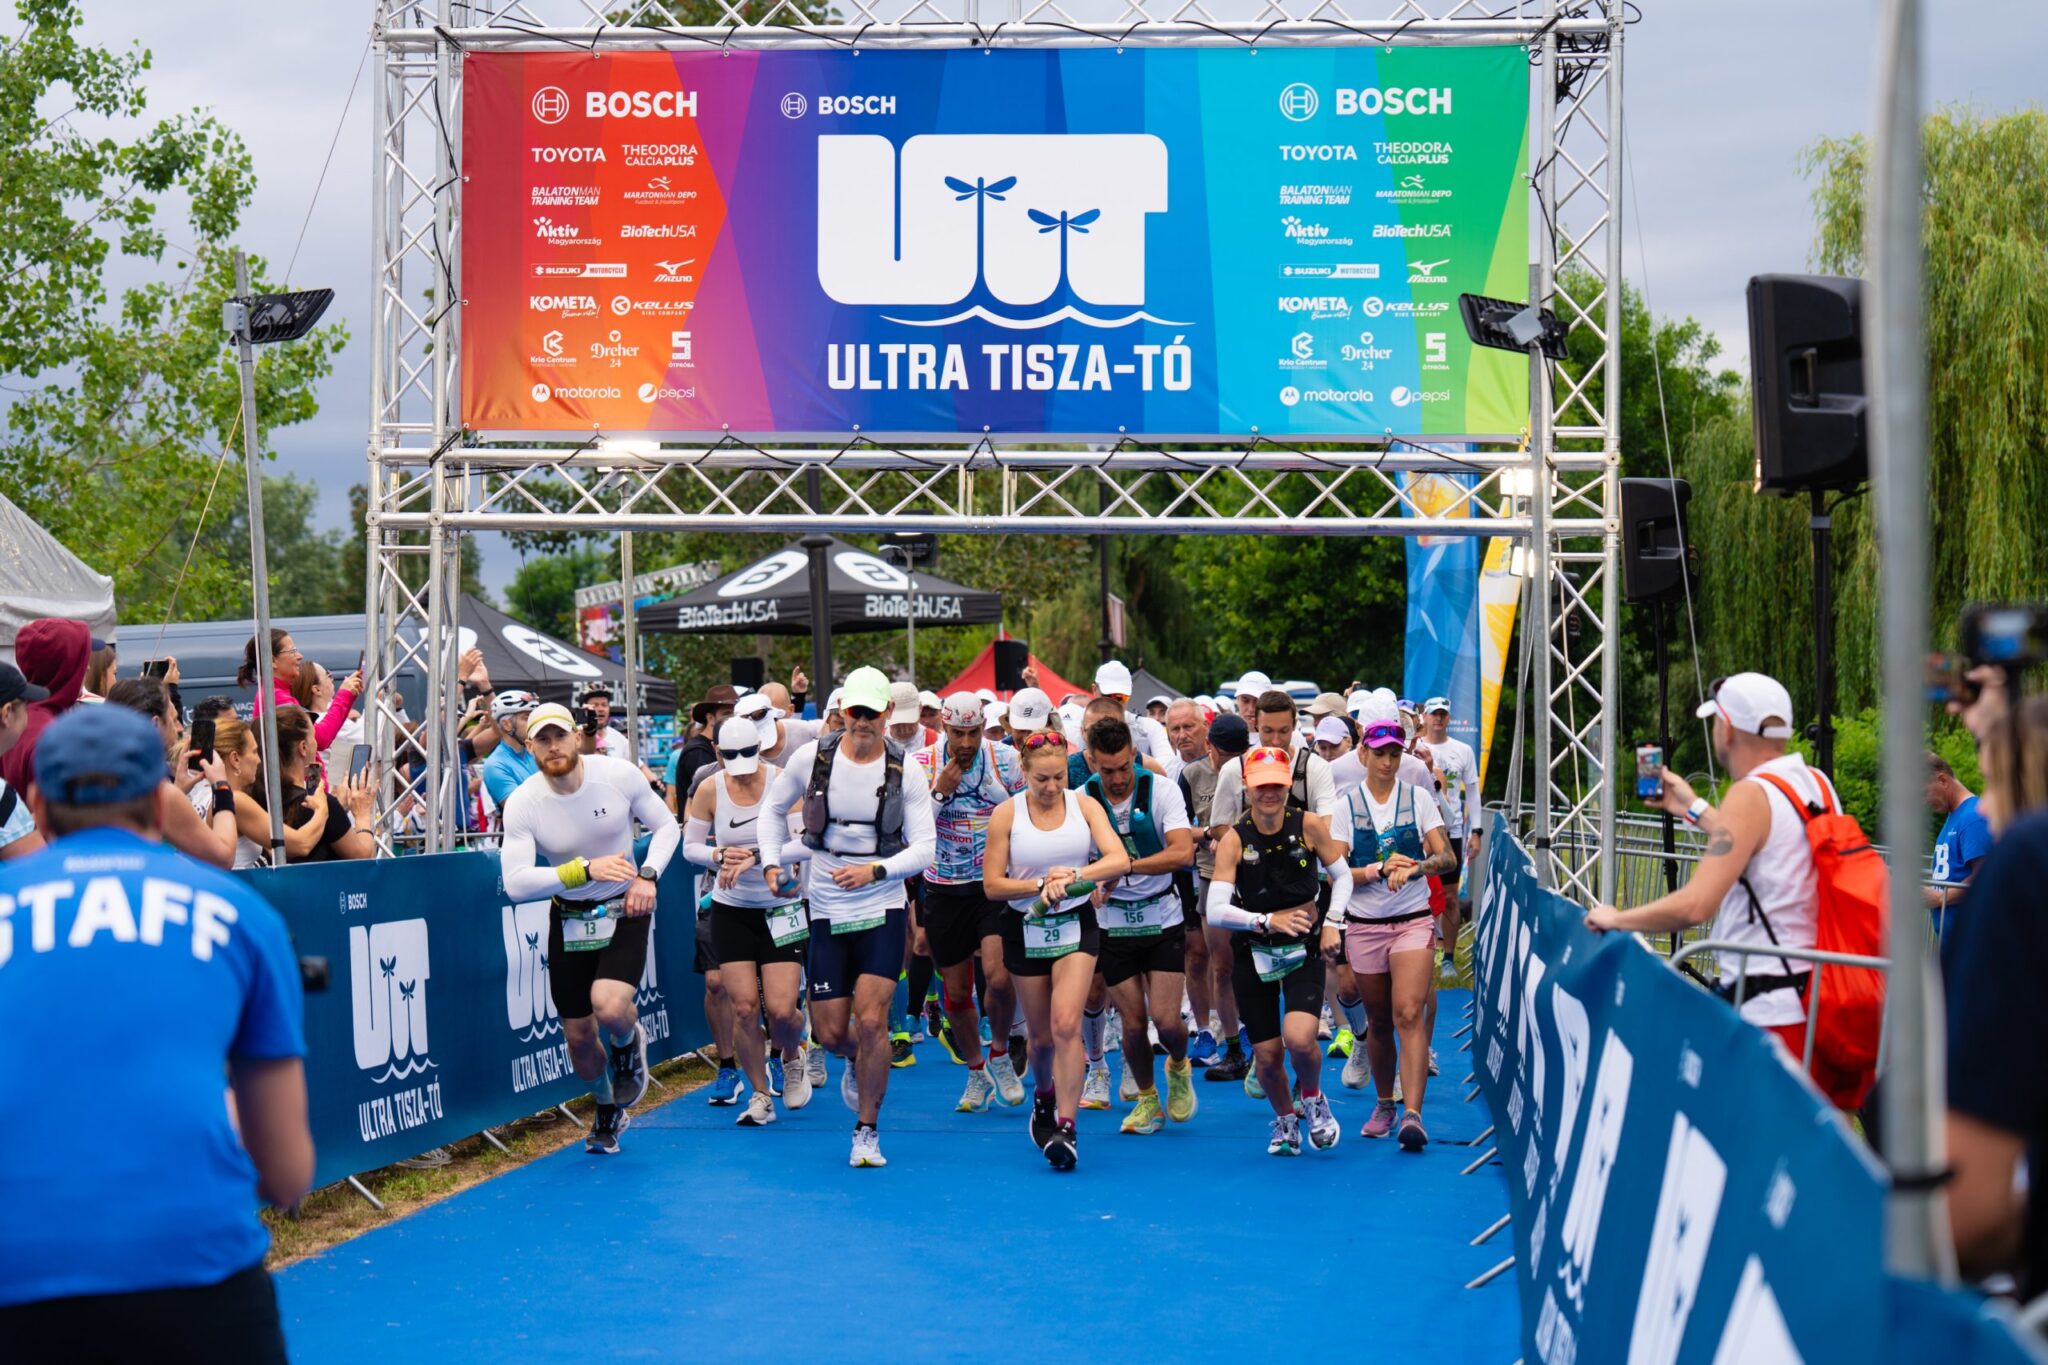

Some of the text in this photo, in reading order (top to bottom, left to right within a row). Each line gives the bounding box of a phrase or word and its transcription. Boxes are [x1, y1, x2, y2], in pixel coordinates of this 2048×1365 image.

[586, 91, 697, 118] BOSCH
[818, 95, 896, 115] BOSCH
[1336, 87, 1452, 115] BOSCH
[621, 144, 698, 155] THEODORA
[1280, 145, 1357, 160] TOYOTA
[1373, 142, 1452, 153] THEODORA
[531, 147, 606, 162] TOYOTA
[532, 186, 601, 196] BALATONMAN
[624, 191, 697, 199] MARATONMAN DEPO
[1280, 185, 1352, 194] BALATONMAN
[1376, 190, 1430, 198] MARATONMAN
[532, 197, 599, 205] TRAINING TEAM
[1280, 195, 1351, 205] TRAINING TEAM
[620, 225, 696, 238] BioTechUSA
[1372, 224, 1452, 238] BioTechUSA
[548, 237, 602, 246] Magyarország
[1296, 236, 1353, 246] Magyarország
[1294, 267, 1331, 275] SUZUKI
[530, 295, 597, 311] KOMETA
[1279, 297, 1348, 313] KOMETA
[590, 343, 640, 359] Dreher
[1340, 344, 1392, 361] Dreher
[610, 359, 622, 368] 24
[828, 335, 1191, 391] ULTRA TISZA-TÓ
[1361, 361, 1374, 370] 24
[555, 386, 621, 398] motorola
[658, 386, 695, 401] pepsi
[1304, 389, 1373, 402] motorola
[1412, 389, 1450, 403] pepsi
[678, 600, 778, 628] BioTechUSA
[938, 809, 968, 819] chiller
[348, 893, 367, 909] BOSCH
[787, 915, 799, 928] 21
[1124, 911, 1144, 923] 156
[584, 921, 597, 935] 13
[1044, 929, 1060, 942] 29
[512, 1052, 537, 1093] ULTRA
[358, 1074, 443, 1142] ULTRA TISZA-TÓ
